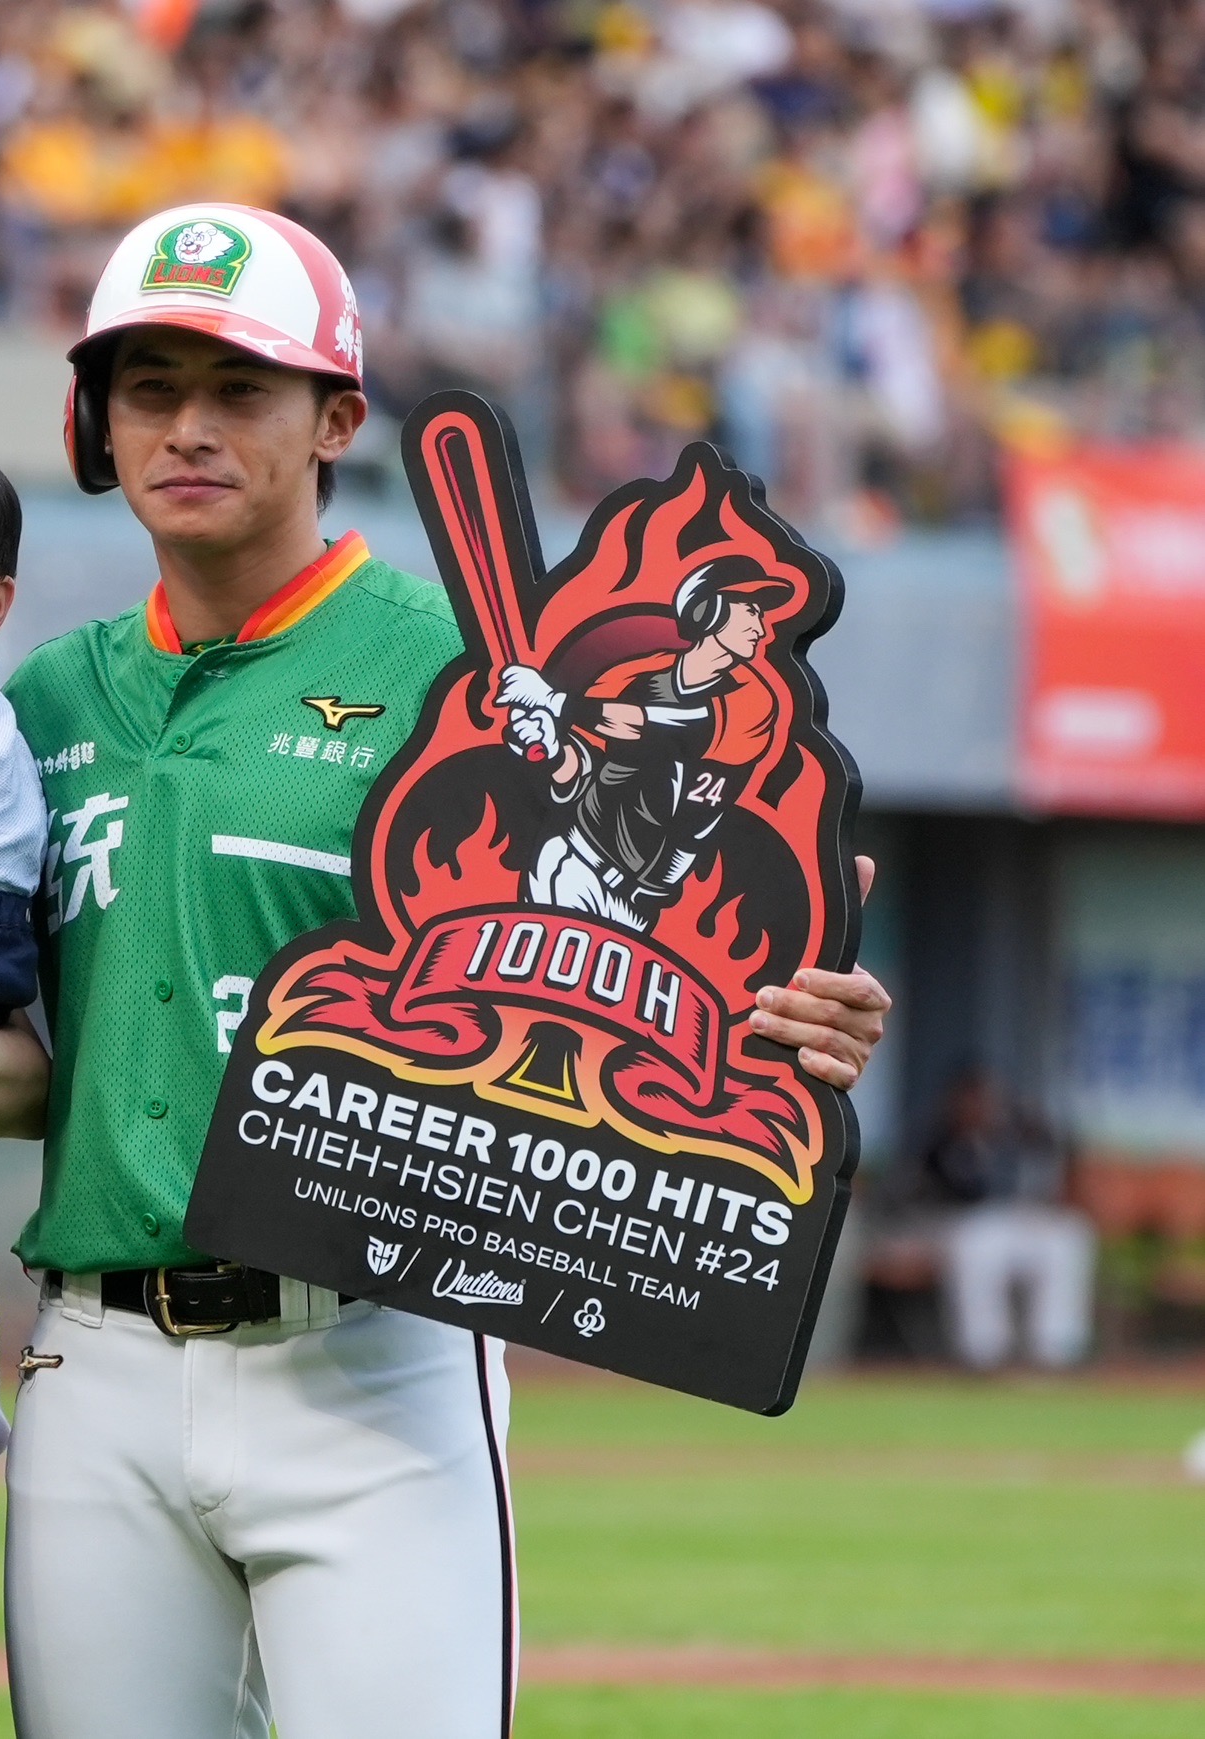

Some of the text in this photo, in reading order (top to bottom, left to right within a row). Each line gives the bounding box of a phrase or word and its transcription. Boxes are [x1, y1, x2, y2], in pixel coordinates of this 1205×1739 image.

[153, 262, 226, 287] LIONS
[267, 732, 375, 768] 兆豐銀行
[686, 771, 727, 807] 24
[251, 1060, 793, 1246] CAREER 1000 HITS
[238, 1109, 780, 1294] CHIEH-HSIEN CHEN #24
[294, 1177, 701, 1310] UNILIONS PRO BASEBALL TEAM
